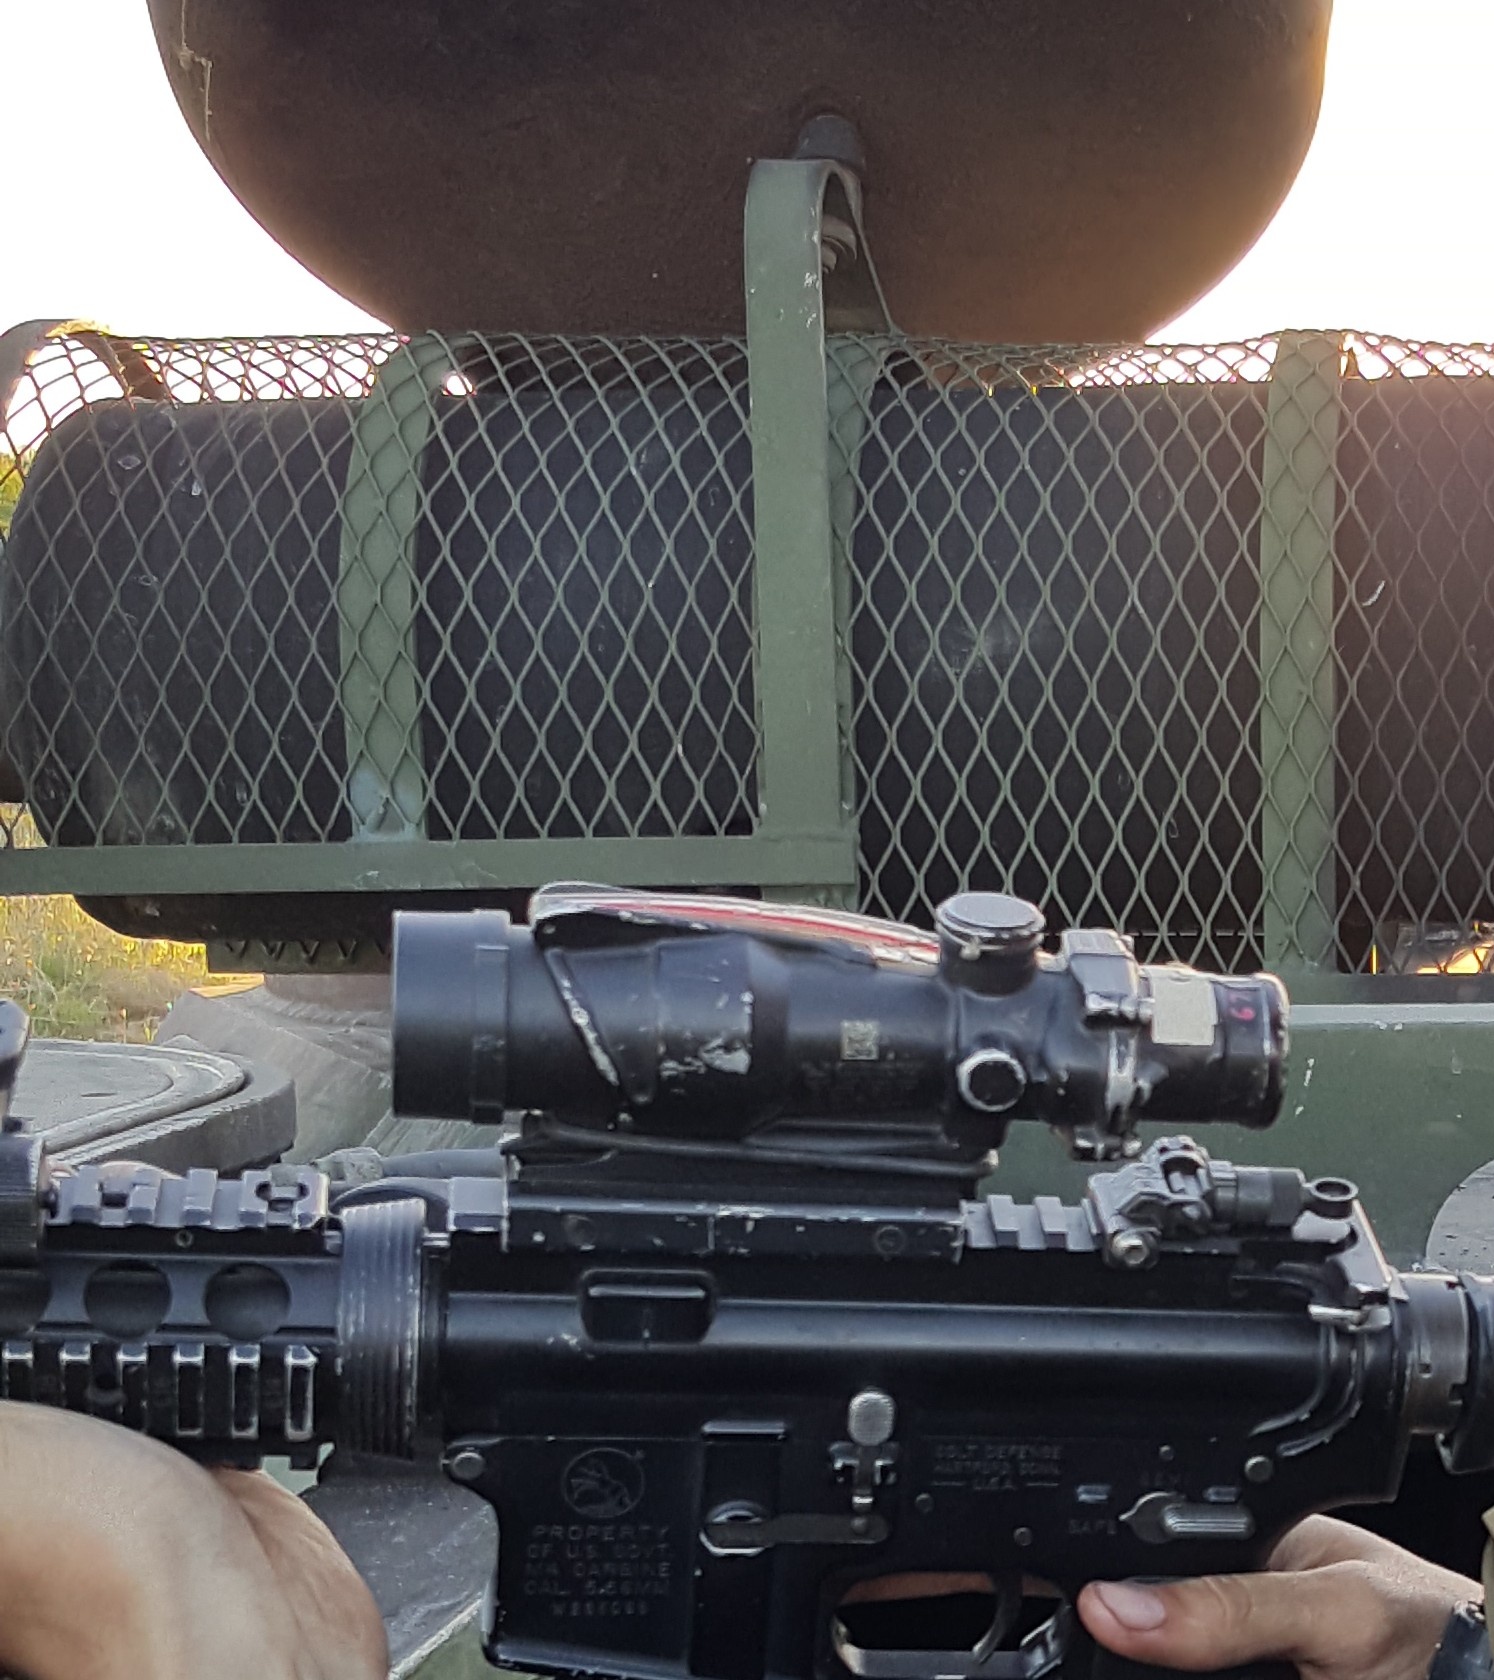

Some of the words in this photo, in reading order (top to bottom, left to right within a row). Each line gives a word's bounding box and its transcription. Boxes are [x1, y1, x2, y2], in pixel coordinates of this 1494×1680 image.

[531, 1524, 670, 1541] PROPERTY
[527, 1543, 553, 1559] OF
[572, 1562, 671, 1578] CARBINE
